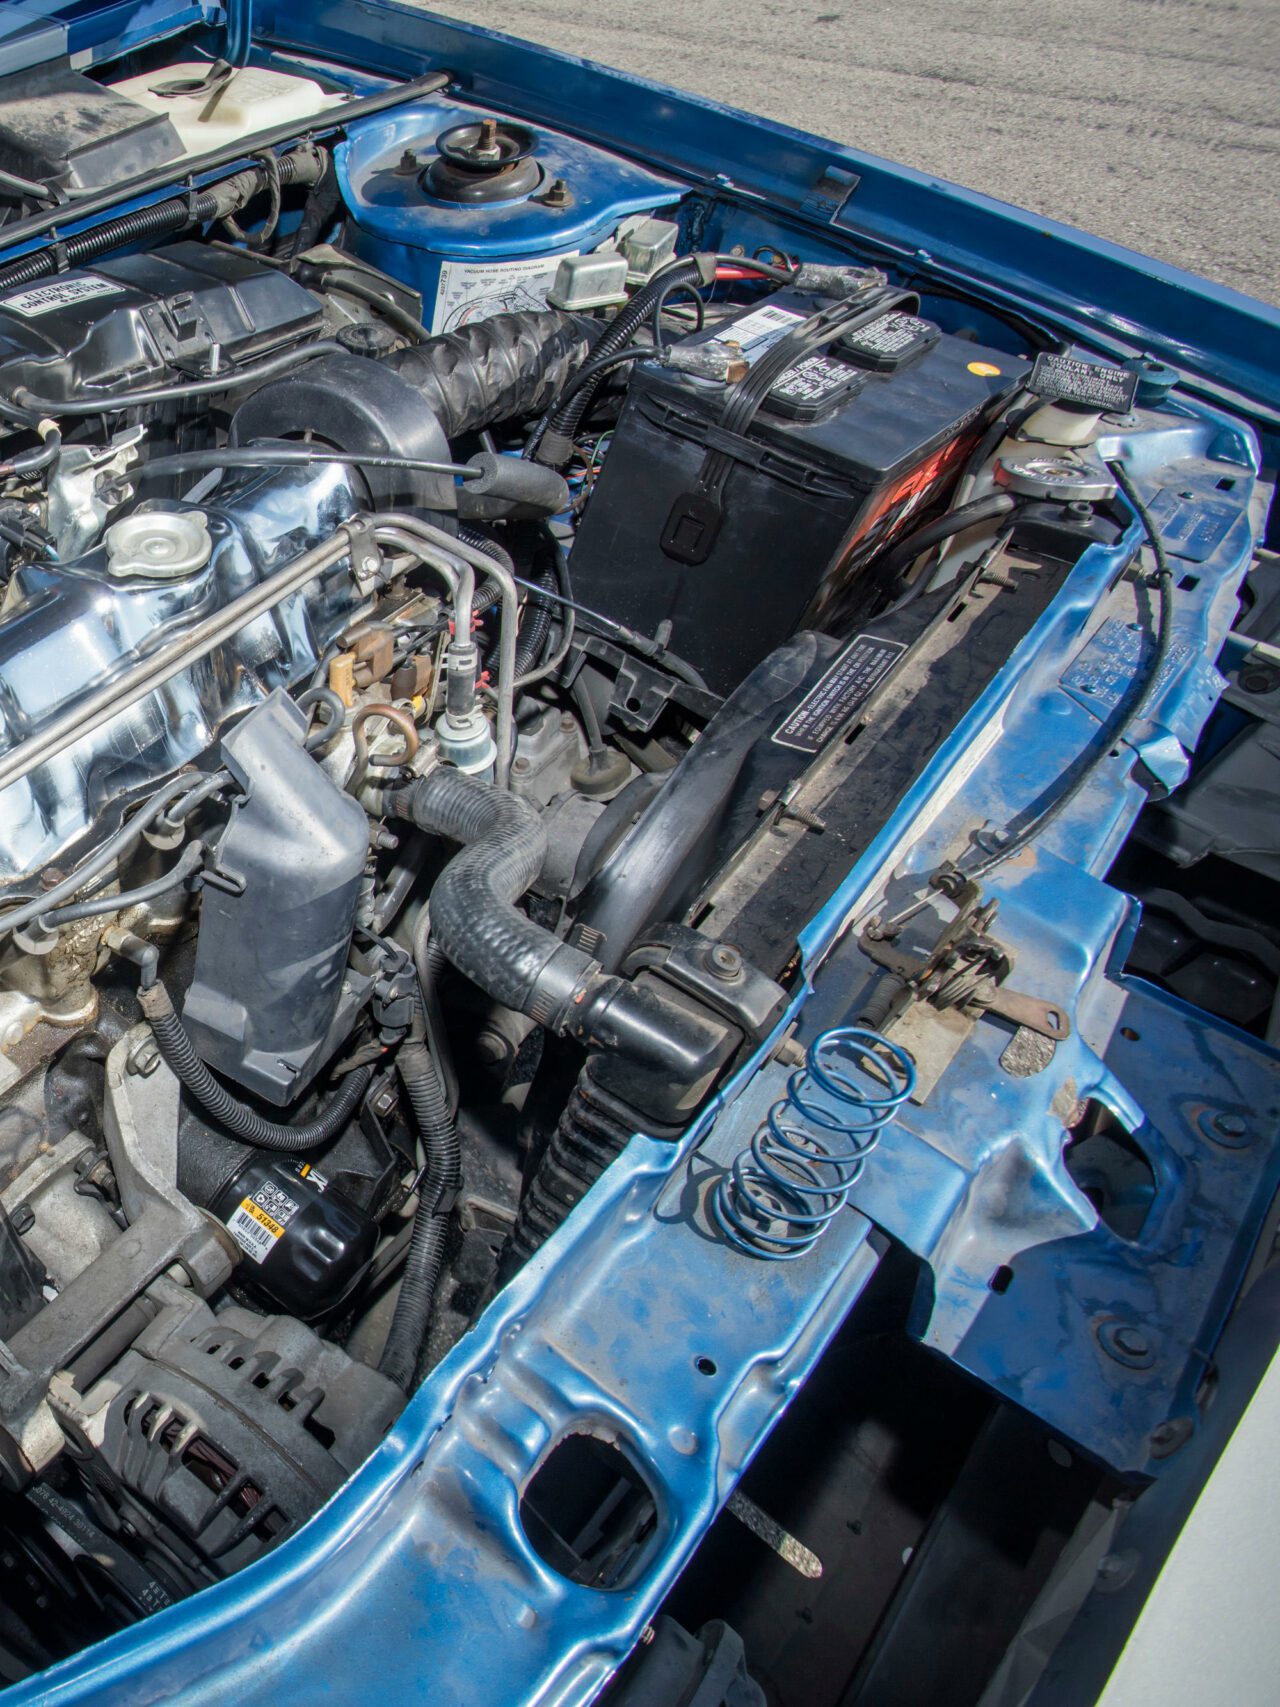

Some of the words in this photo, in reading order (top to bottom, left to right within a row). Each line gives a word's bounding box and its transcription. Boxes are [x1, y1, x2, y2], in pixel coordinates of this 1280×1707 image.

[21, 291, 68, 308] CONTROL
[72, 283, 108, 296] SYSTEM
[24, 281, 87, 301] ELECTRONIC
[1050, 361, 1094, 376] COOLANT
[1100, 373, 1124, 383] ONLY
[1095, 366, 1130, 378] ENGINE
[785, 710, 809, 734] CAUTION
[256, 1212, 280, 1234] 51348
